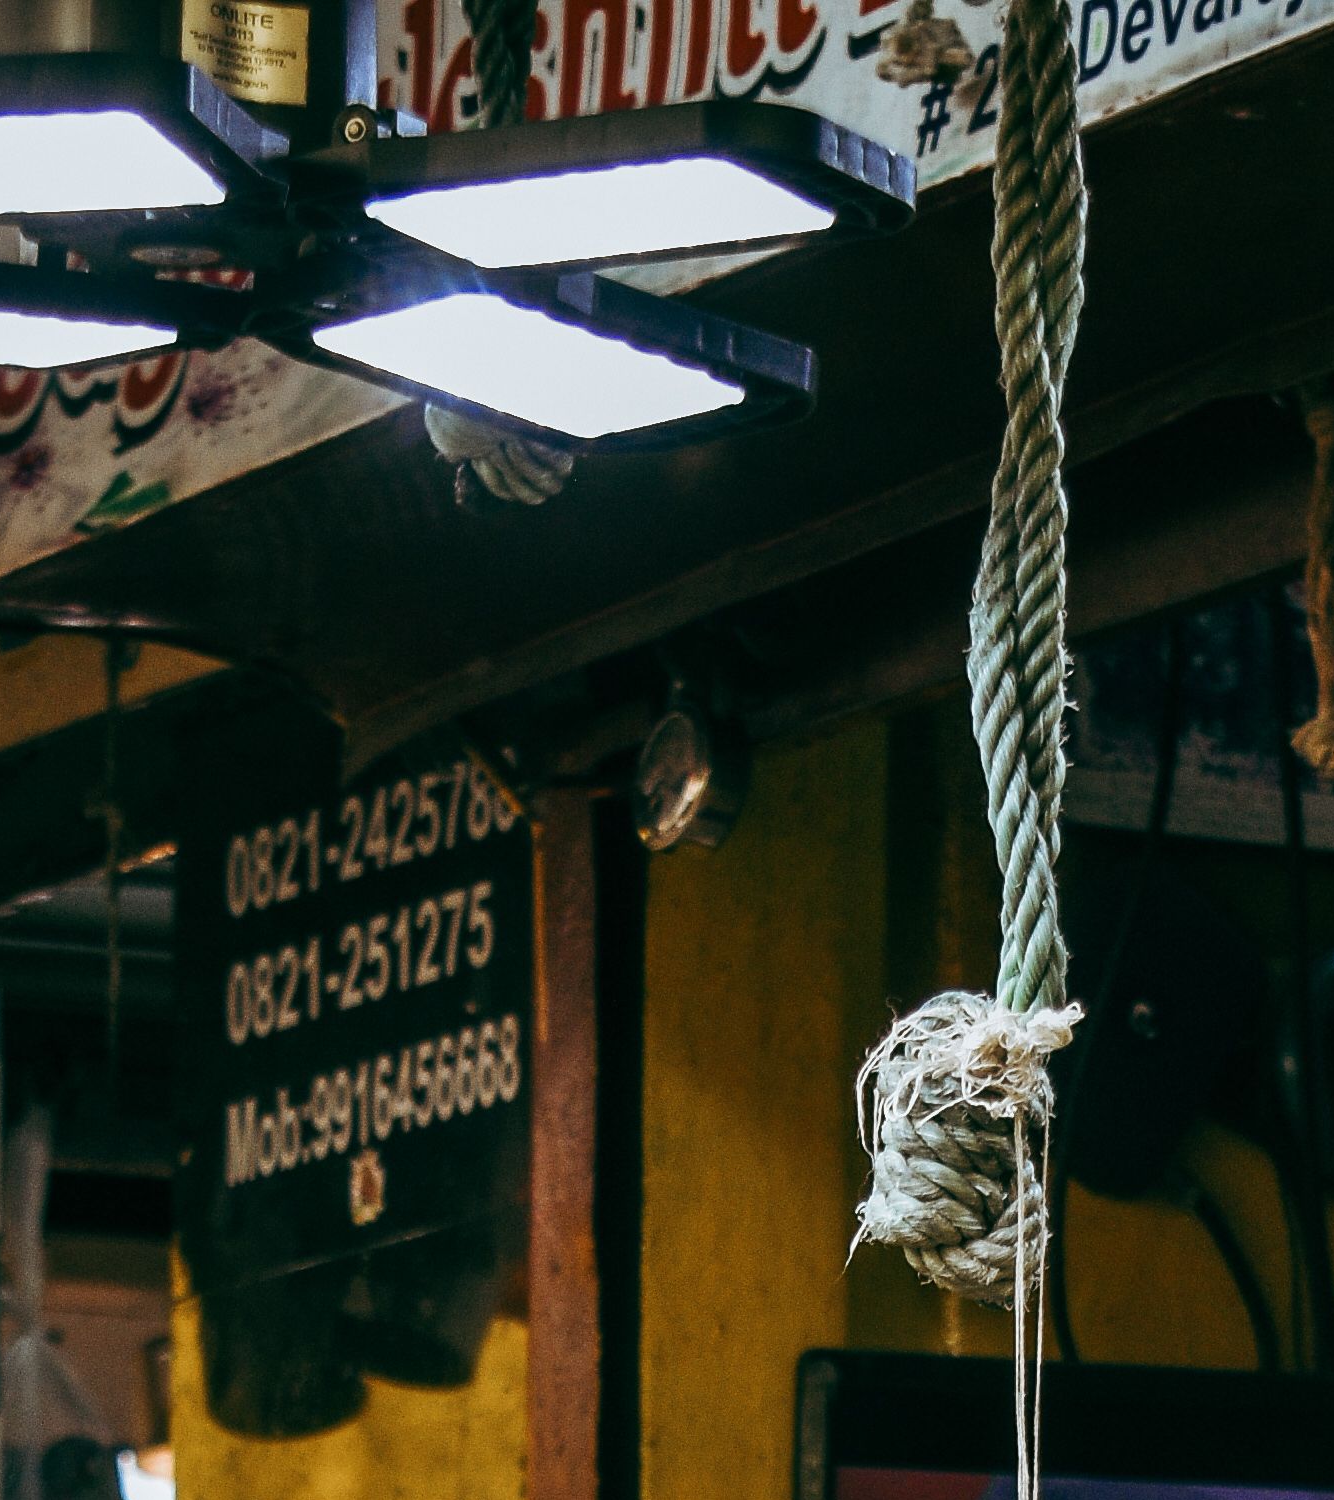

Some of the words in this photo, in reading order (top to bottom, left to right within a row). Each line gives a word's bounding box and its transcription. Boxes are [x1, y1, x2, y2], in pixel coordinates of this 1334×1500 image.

[210, 3, 274, 30] ONLITE
[227, 879, 494, 1046] 0821-251275
[225, 1012, 521, 1188] Mob:9916456668
